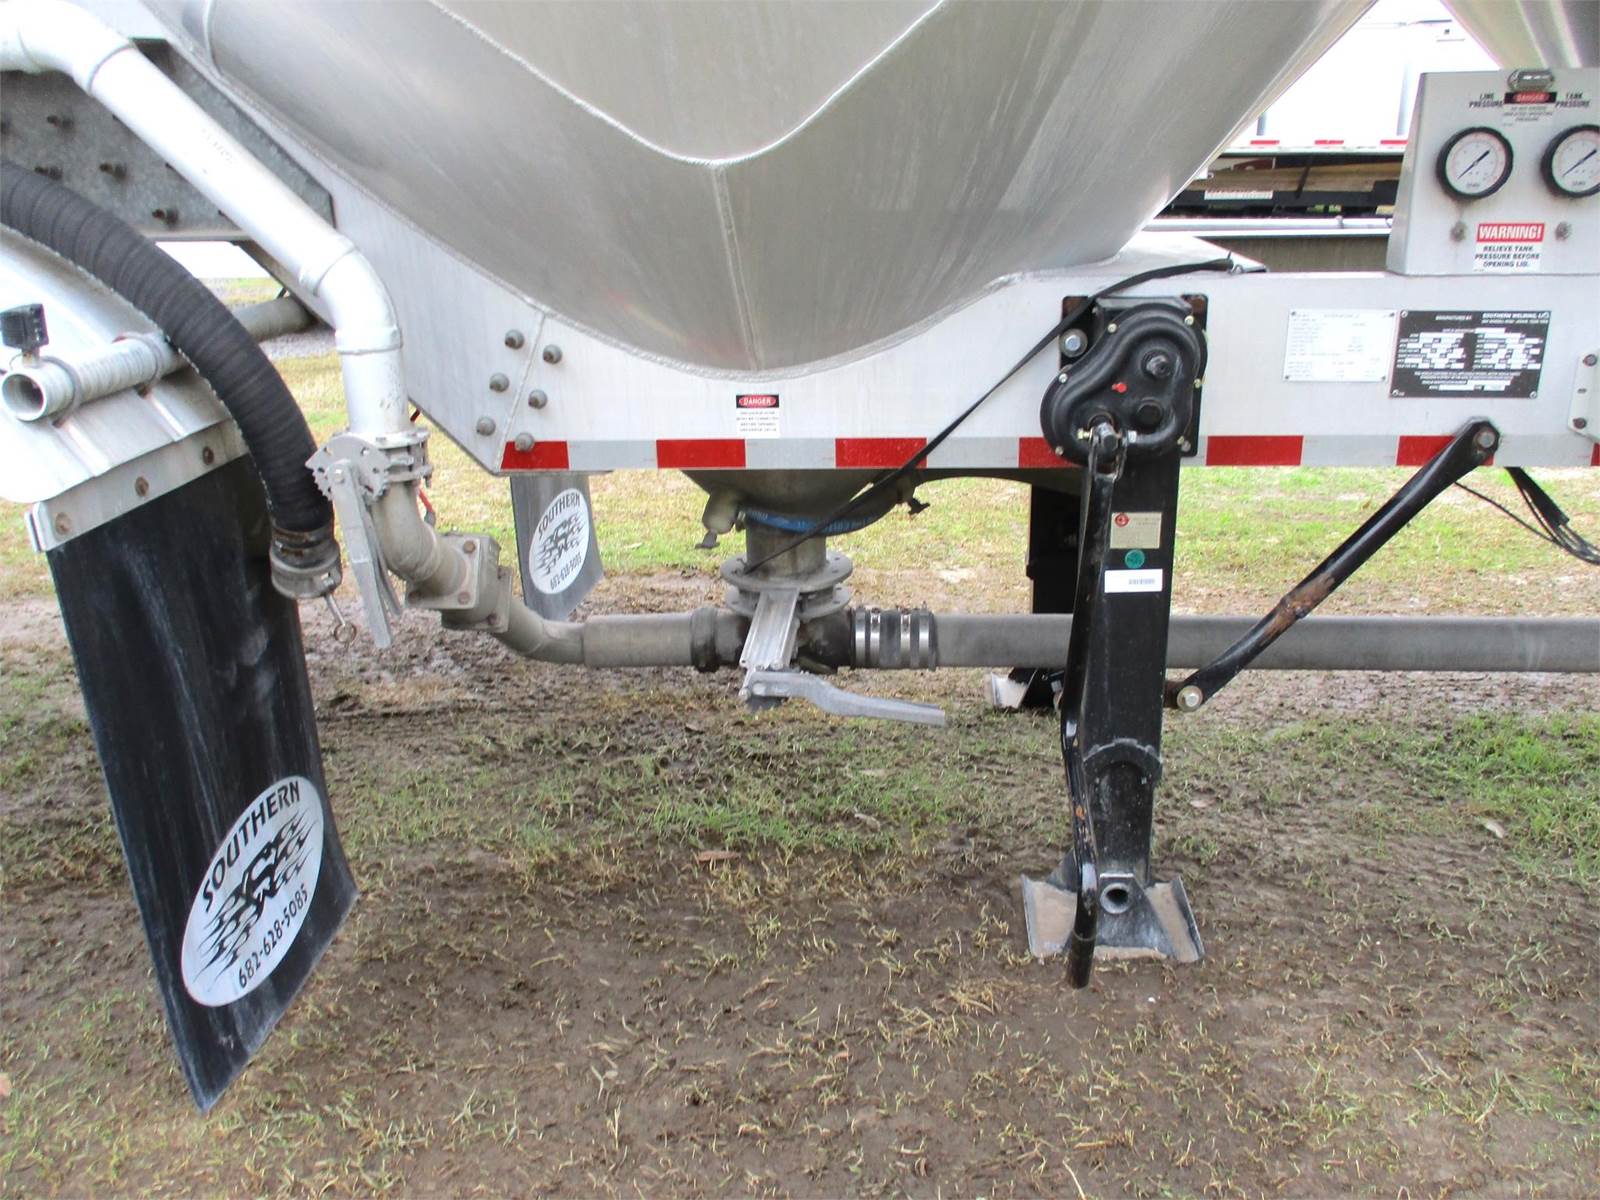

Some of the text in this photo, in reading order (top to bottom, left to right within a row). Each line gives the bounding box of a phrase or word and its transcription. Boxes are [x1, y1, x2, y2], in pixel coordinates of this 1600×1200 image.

[1468, 100, 1503, 108] PRESSURE
[1555, 100, 1591, 108] PRESSURE
[1478, 224, 1542, 240] WARNING!
[537, 492, 581, 540] SOUTHERN
[202, 779, 301, 913] SOUTHERN
[238, 886, 309, 988] 682-628-5085
